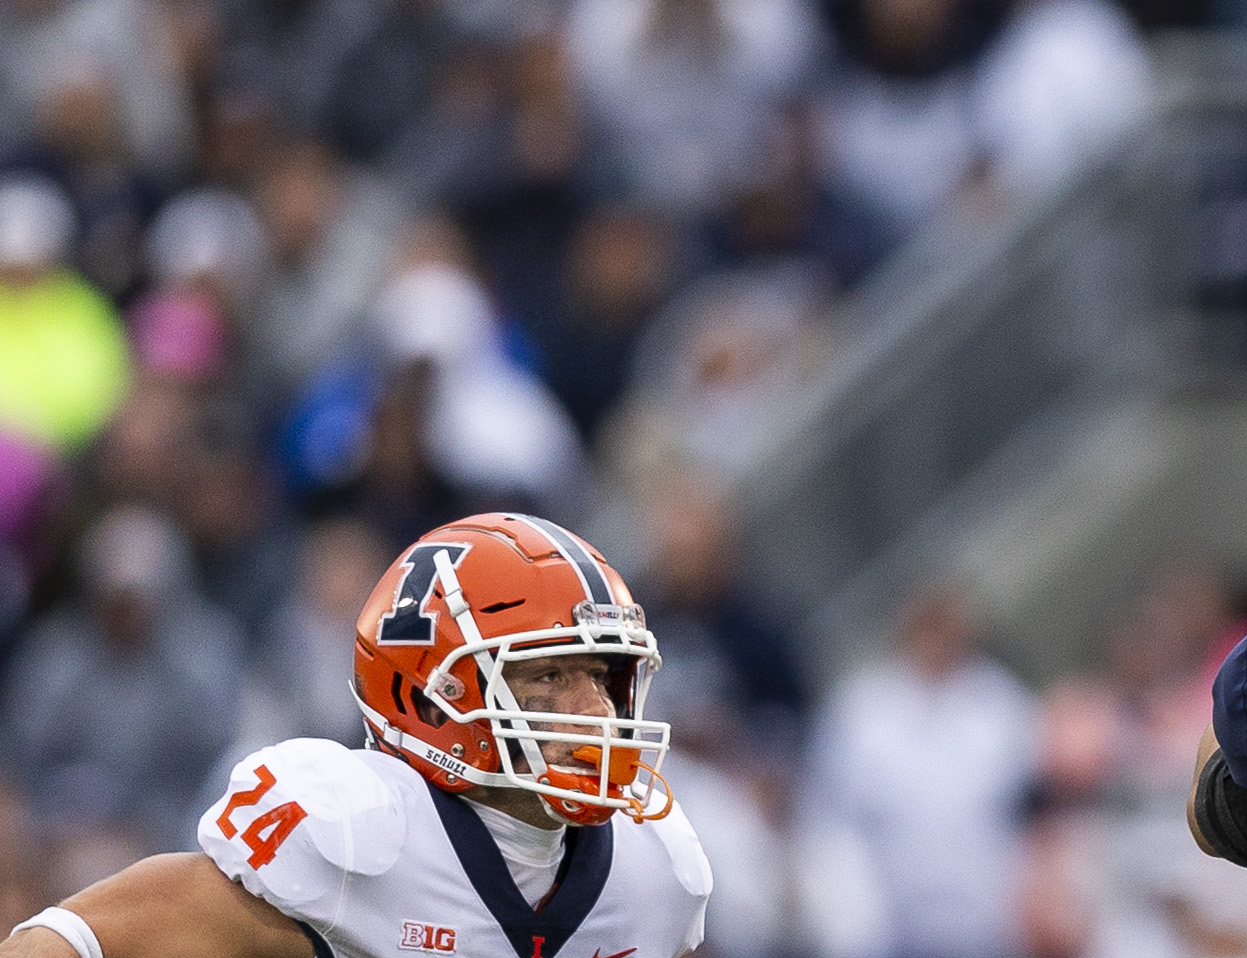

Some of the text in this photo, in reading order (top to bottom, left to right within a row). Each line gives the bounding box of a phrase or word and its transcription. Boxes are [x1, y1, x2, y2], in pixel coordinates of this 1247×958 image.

[376, 541, 474, 646] I
[425, 748, 467, 776] schutt
[216, 763, 309, 871] 24
